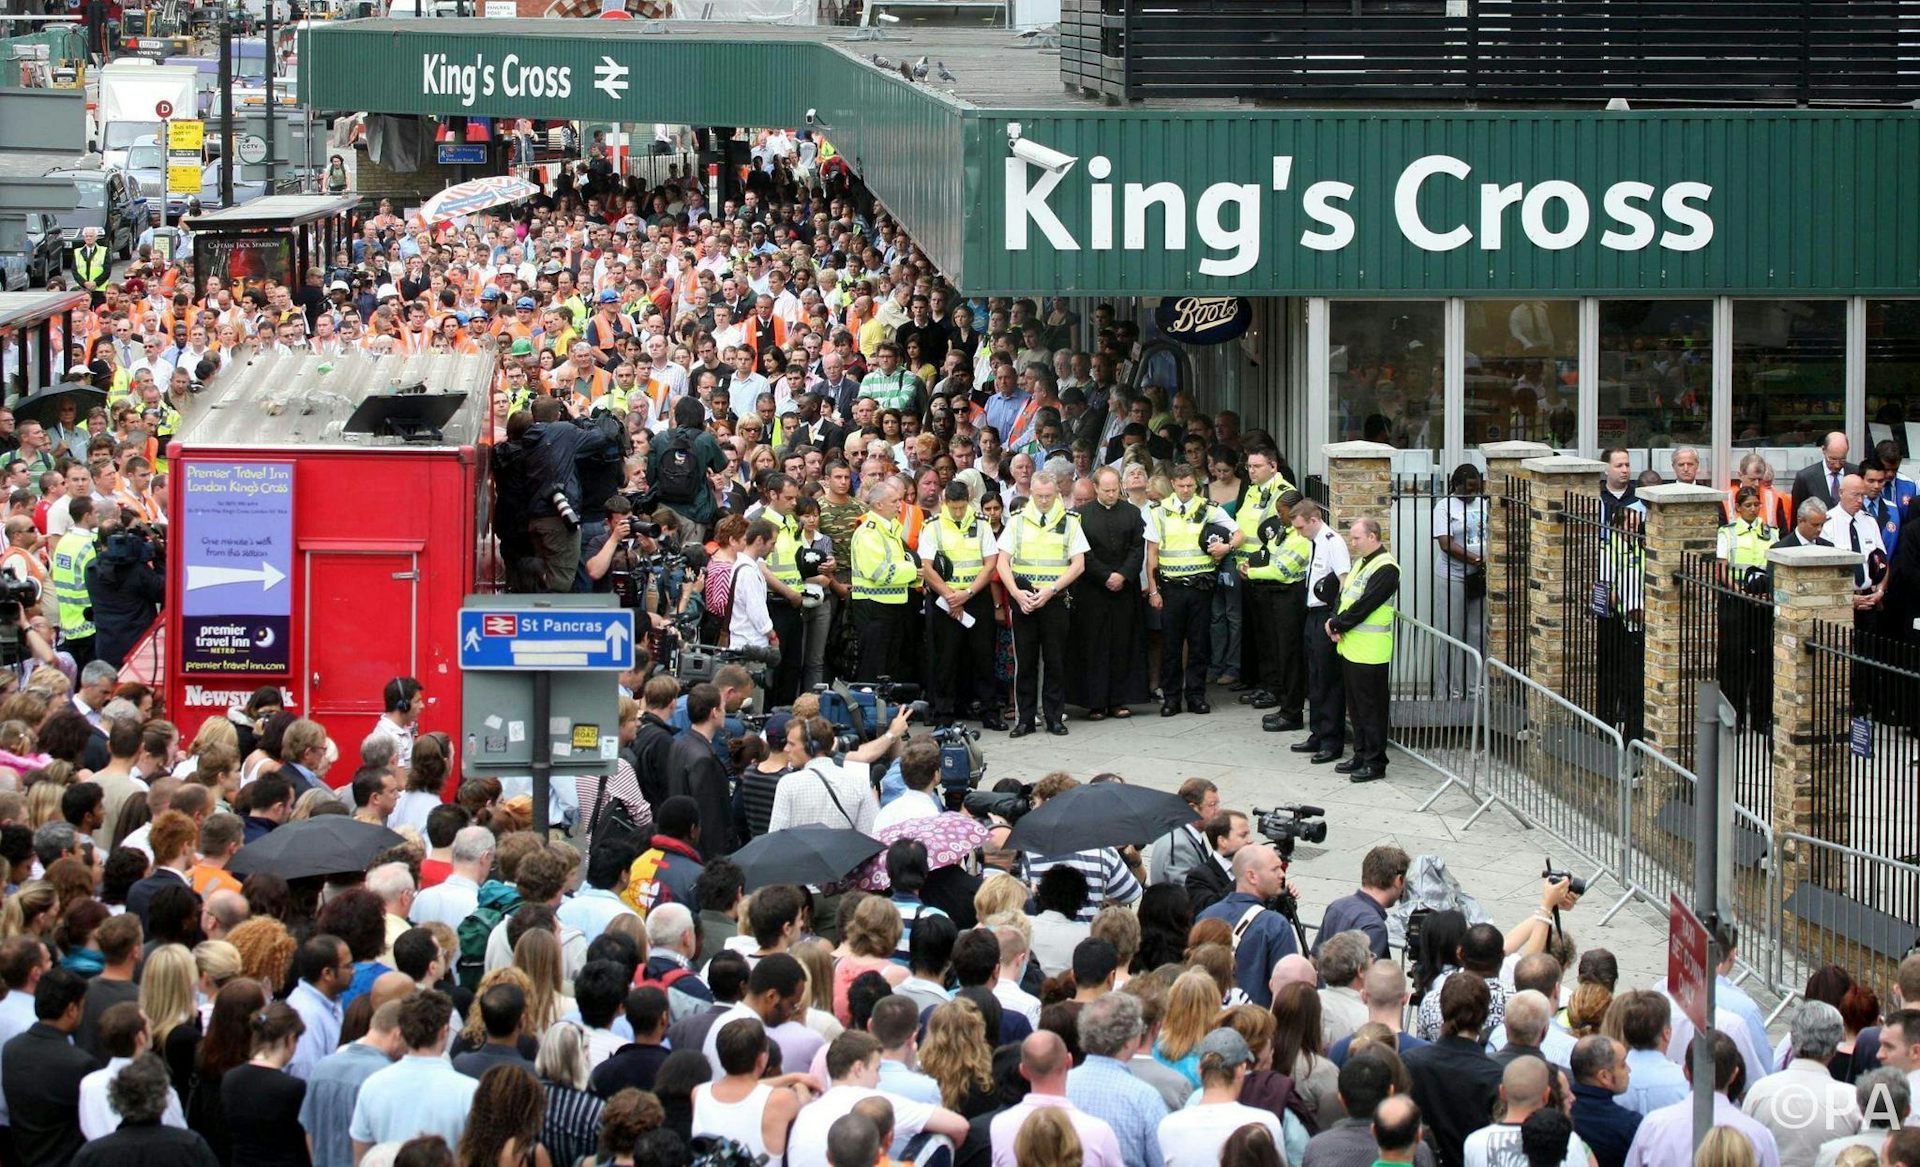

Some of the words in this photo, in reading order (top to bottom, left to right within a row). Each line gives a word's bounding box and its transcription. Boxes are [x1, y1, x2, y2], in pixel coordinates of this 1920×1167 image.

[423, 53, 495, 107] King's
[502, 54, 571, 98] Cross
[161, 103, 170, 114] D
[1005, 155, 1355, 276] King's
[1394, 154, 1714, 251] Cross
[1167, 296, 1239, 333] Boots
[187, 465, 231, 479] Premier
[233, 466, 267, 479] Travel
[269, 467, 289, 479] Inn
[187, 479, 226, 492] London
[260, 483, 288, 494] Cross
[201, 536, 219, 545] One
[255, 536, 272, 546] walk
[206, 547, 226, 557] from
[227, 547, 241, 557] this
[200, 623, 247, 637] premier
[521, 618, 539, 632] St
[544, 618, 602, 632] Pancras
[195, 636, 229, 647] travel
[231, 635, 250, 647] inn
[209, 647, 236, 655] METRO
